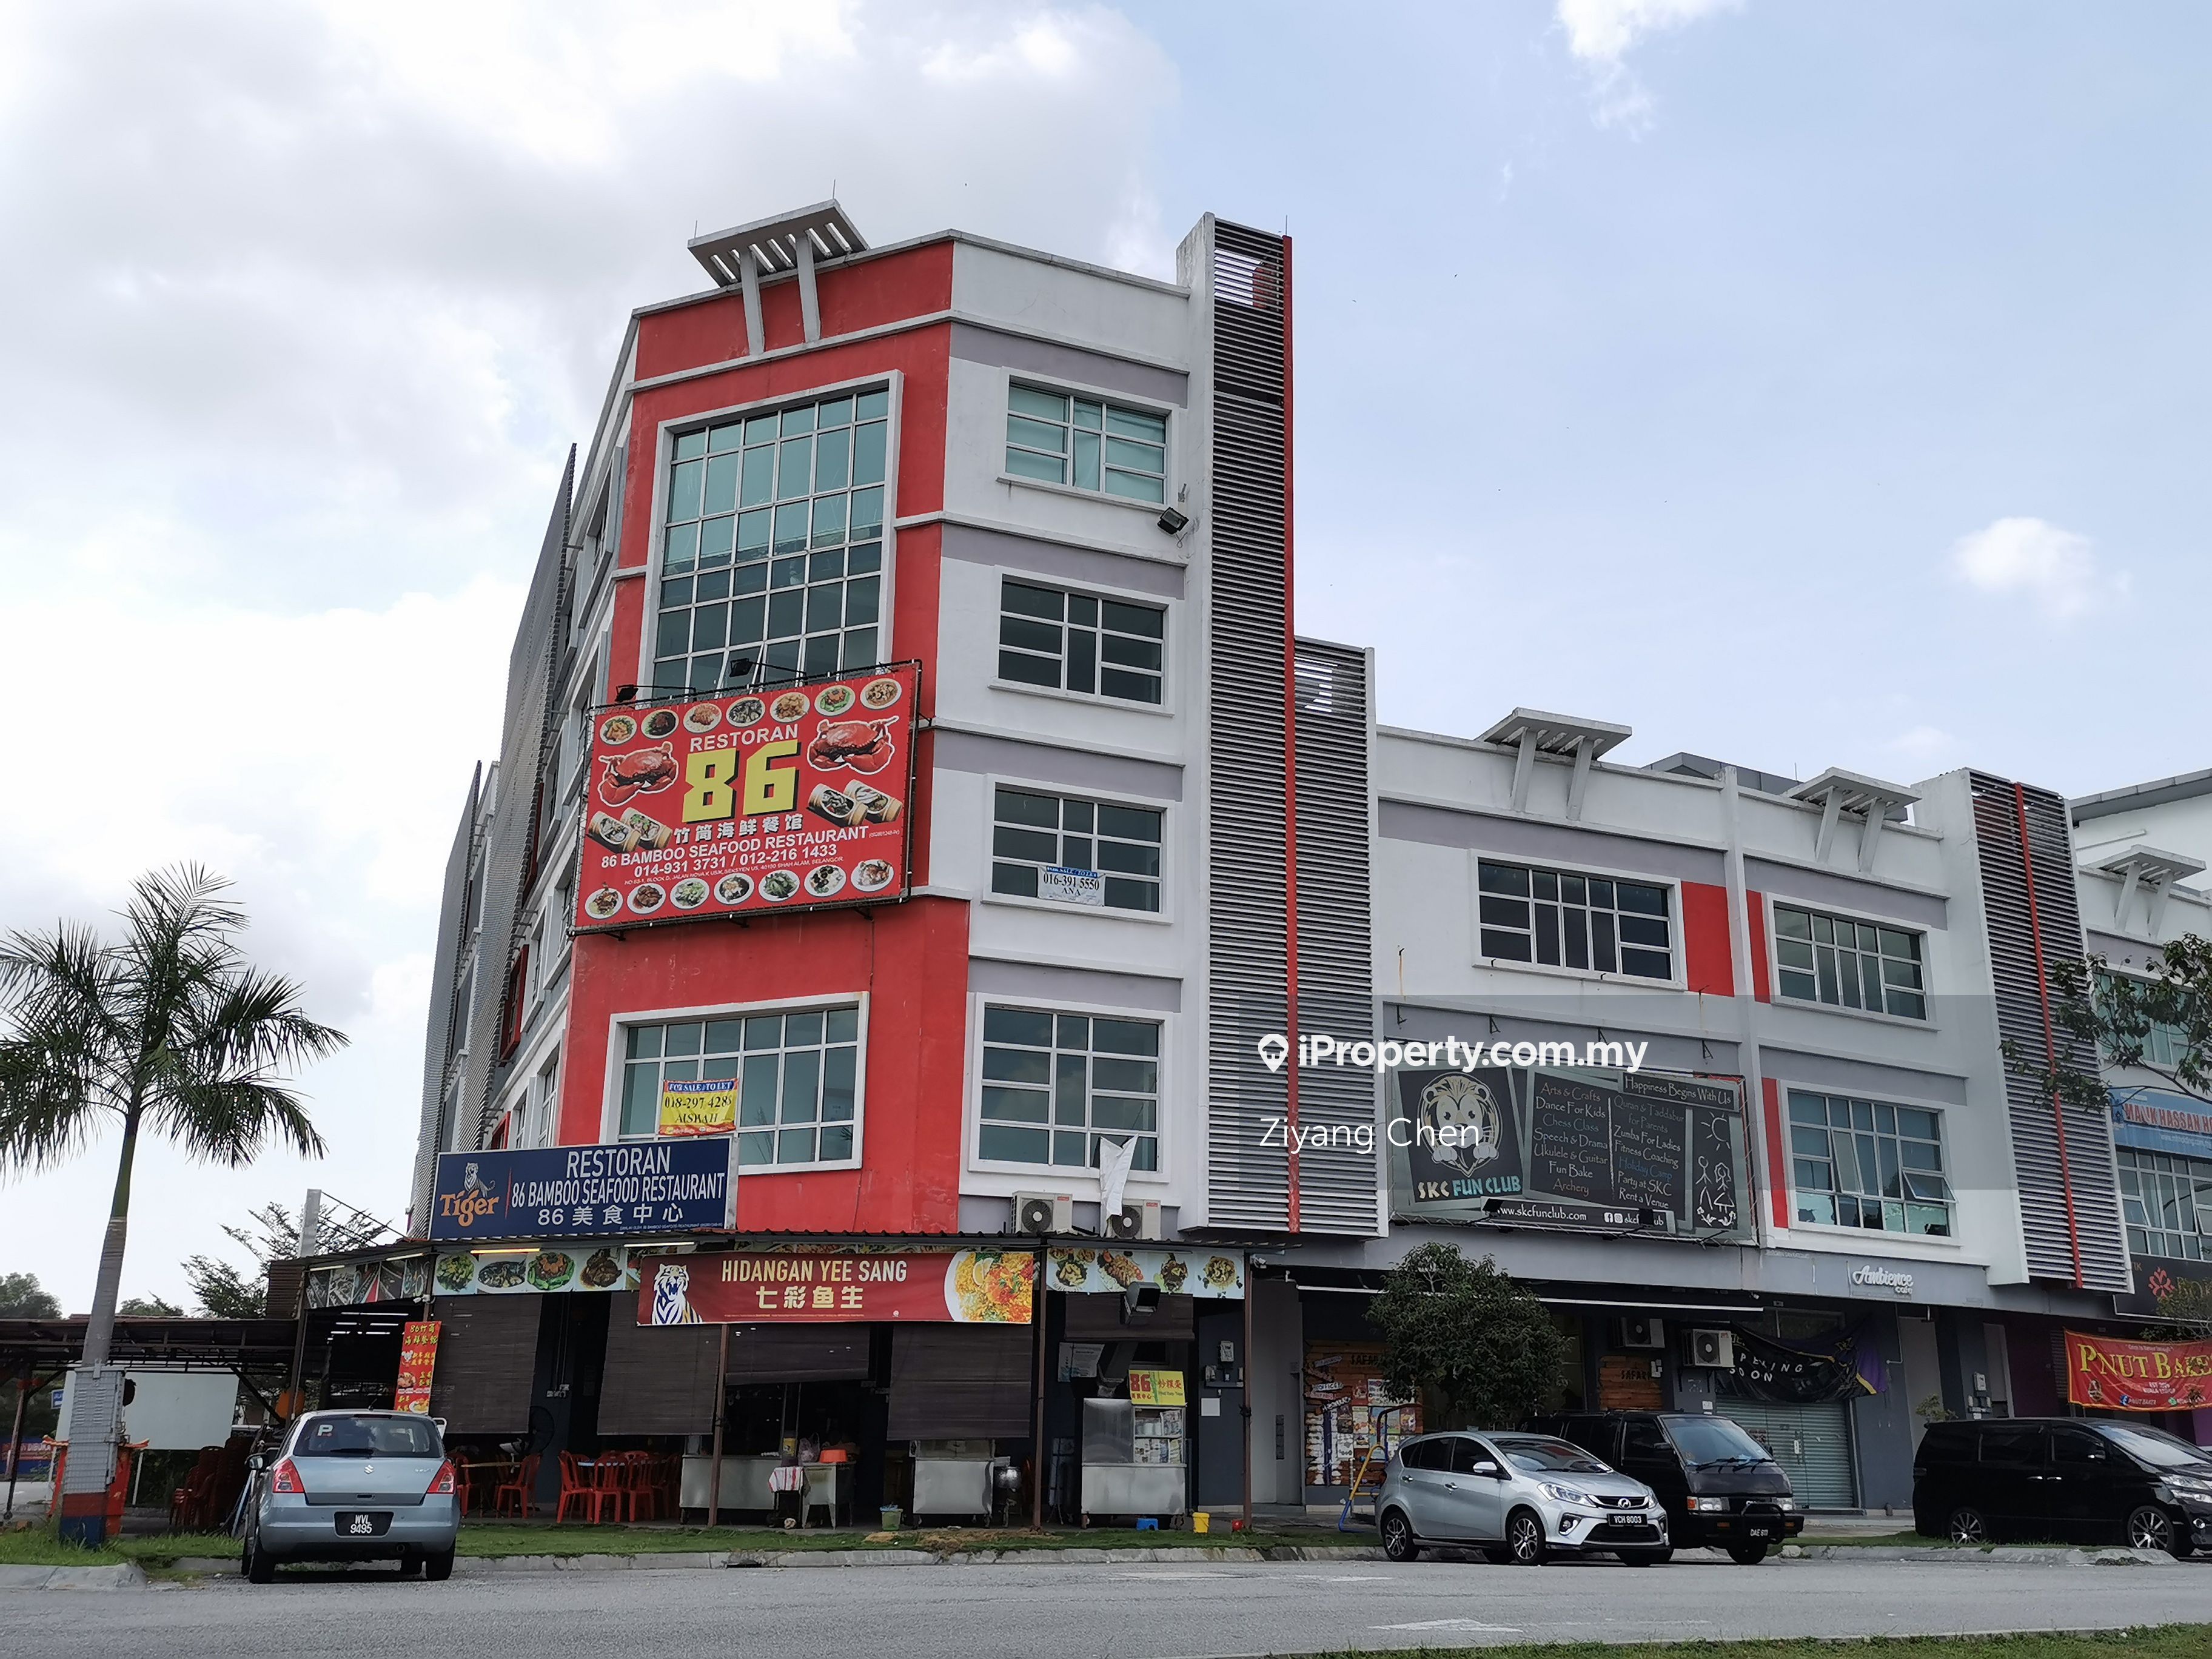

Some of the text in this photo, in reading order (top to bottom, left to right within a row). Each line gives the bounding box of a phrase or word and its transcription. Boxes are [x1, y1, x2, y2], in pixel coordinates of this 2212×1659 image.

[689, 723, 799, 752] RESTORAN
[682, 739, 801, 823] 86
[601, 855, 617, 868] 86
[621, 848, 685, 866] BAMBOO
[689, 839, 762, 859] SEAFOOD
[765, 825, 869, 850] RESTAURANT
[634, 843, 837, 877] 014-931 3731 / 012-216 1433
[811, 856, 844, 865] SELANGOR
[1044, 872, 1100, 891] 016-391 5550
[1062, 887, 1081, 896] ANA
[1541, 1082, 1601, 1102] Arts & Crafts
[1625, 1076, 1731, 1105] Happiness Begins With Us
[1535, 1096, 1606, 1119] Dance For Kids
[1614, 1094, 1639, 1110] Quran
[1647, 1102, 1684, 1122] Taddabur
[1543, 1113, 1600, 1133] Chess Class
[1641, 1116, 1668, 1133] Parents
[2159, 1108, 2200, 1131] HASSAN
[1533, 1127, 1608, 1150] Speech & Drama
[1614, 1124, 1681, 1152] Zumba For Ladies
[566, 1145, 671, 1178] RESTORAN
[1533, 1144, 1609, 1165] Ukulele & Guitar
[1615, 1139, 1679, 1170] Fitness Coaching
[1548, 1160, 1593, 1178] Fun Bake
[1618, 1156, 1672, 1180] Holiday Camp
[512, 1173, 725, 1208] 86 BAMBOO SEAFOOD RESTAURANT
[1418, 1175, 1521, 1199] SKC FUN CLUB
[1552, 1178, 1589, 1196] Archery
[1618, 1170, 1672, 1196] Party at SKC
[440, 1189, 500, 1227] Tiger
[1618, 1187, 1637, 1202] Rent
[1644, 1194, 1669, 1209] Venue
[538, 1202, 683, 1226] 86 美食中心
[1498, 1203, 1587, 1221] ww.skcfunclub.com
[722, 1260, 907, 1282] HIDANGAN YEE SANG
[1852, 1265, 1914, 1287] Ambience
[756, 1285, 863, 1309] 七彩鱼生
[2077, 1343, 2148, 1379] PNUT
[1130, 1373, 1151, 1392] 86
[317, 1424, 333, 1436] P
[350, 1523, 373, 1534] 9495
[355, 1514, 370, 1525] WVL
